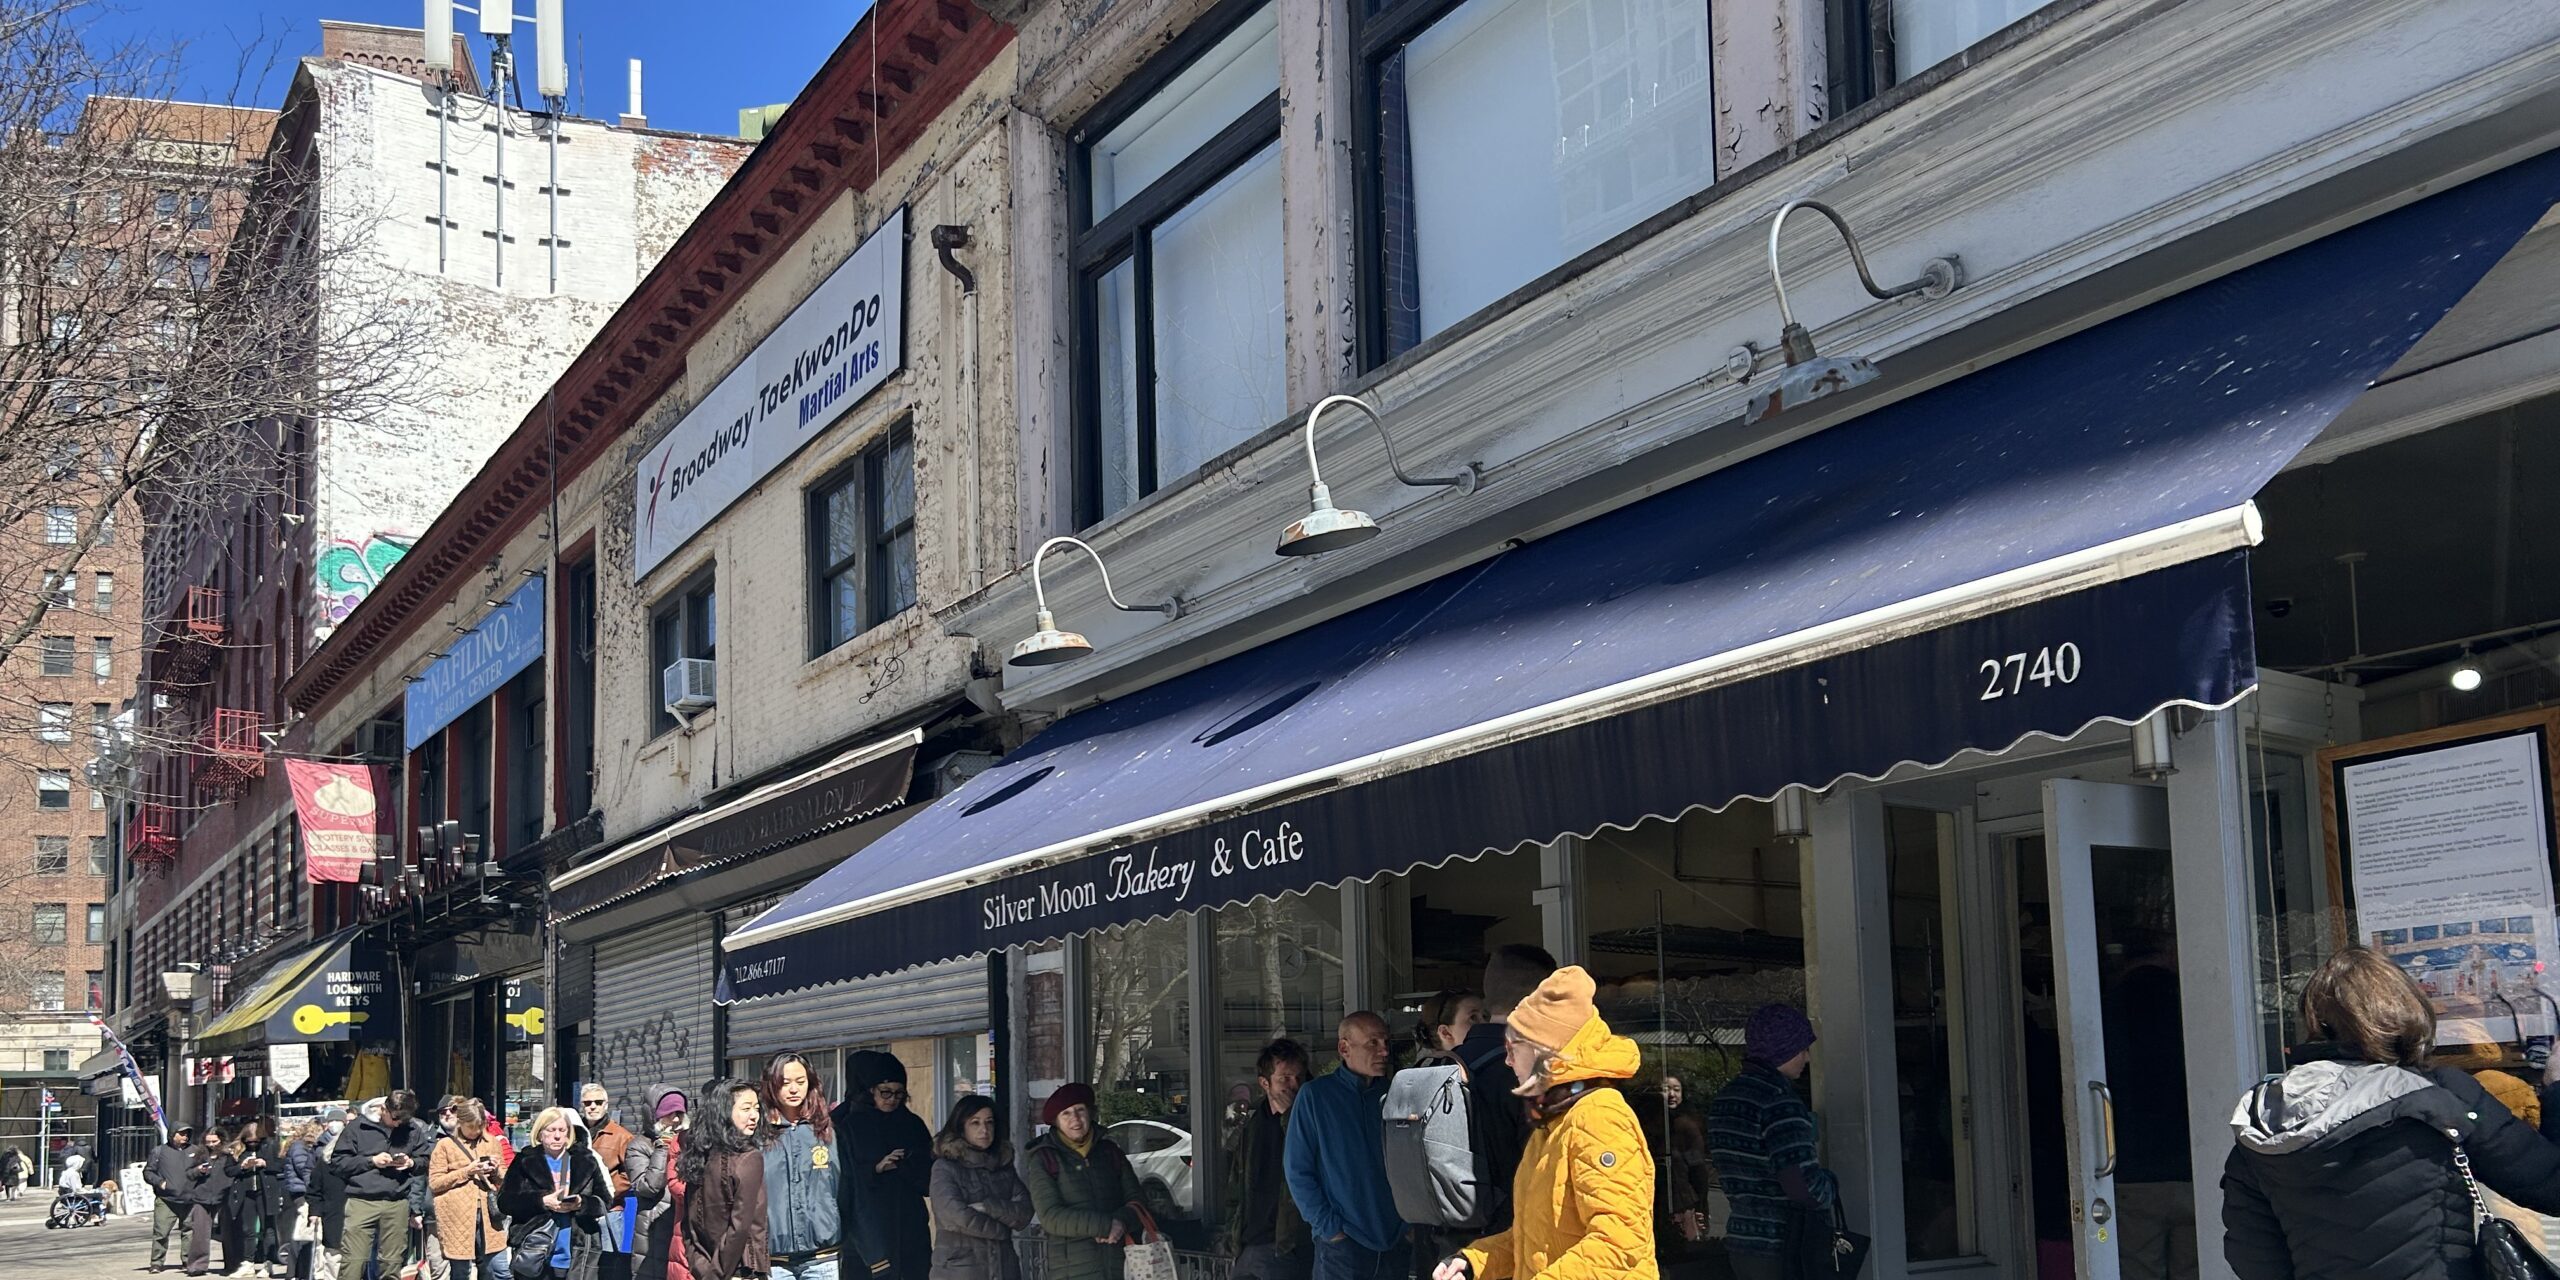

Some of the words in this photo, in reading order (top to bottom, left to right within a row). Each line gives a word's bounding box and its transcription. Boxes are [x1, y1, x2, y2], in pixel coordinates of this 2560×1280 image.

[799, 371, 847, 430] Martial
[850, 338, 880, 388] Arts
[670, 405, 754, 502] Broadway
[759, 293, 880, 423] TaeKwonDo
[429, 613, 509, 706] NAFILINO
[1979, 641, 2082, 701] 2740
[468, 659, 503, 698] CENTER
[317, 833, 353, 842] POTTERY
[314, 844, 349, 853] CLASSES
[984, 895, 1035, 931] Silver
[1039, 881, 1097, 917] Moon
[1106, 846, 1196, 902] Bakery
[1210, 837, 1234, 878] &
[1241, 821, 1304, 870] Cafe
[327, 971, 381, 982] HARDWARE
[327, 983, 382, 995] LOCKSMITH
[336, 995, 370, 1007] KEYS
[237, 1061, 261, 1070] RENT
[237, 1069, 262, 1078] HERE
